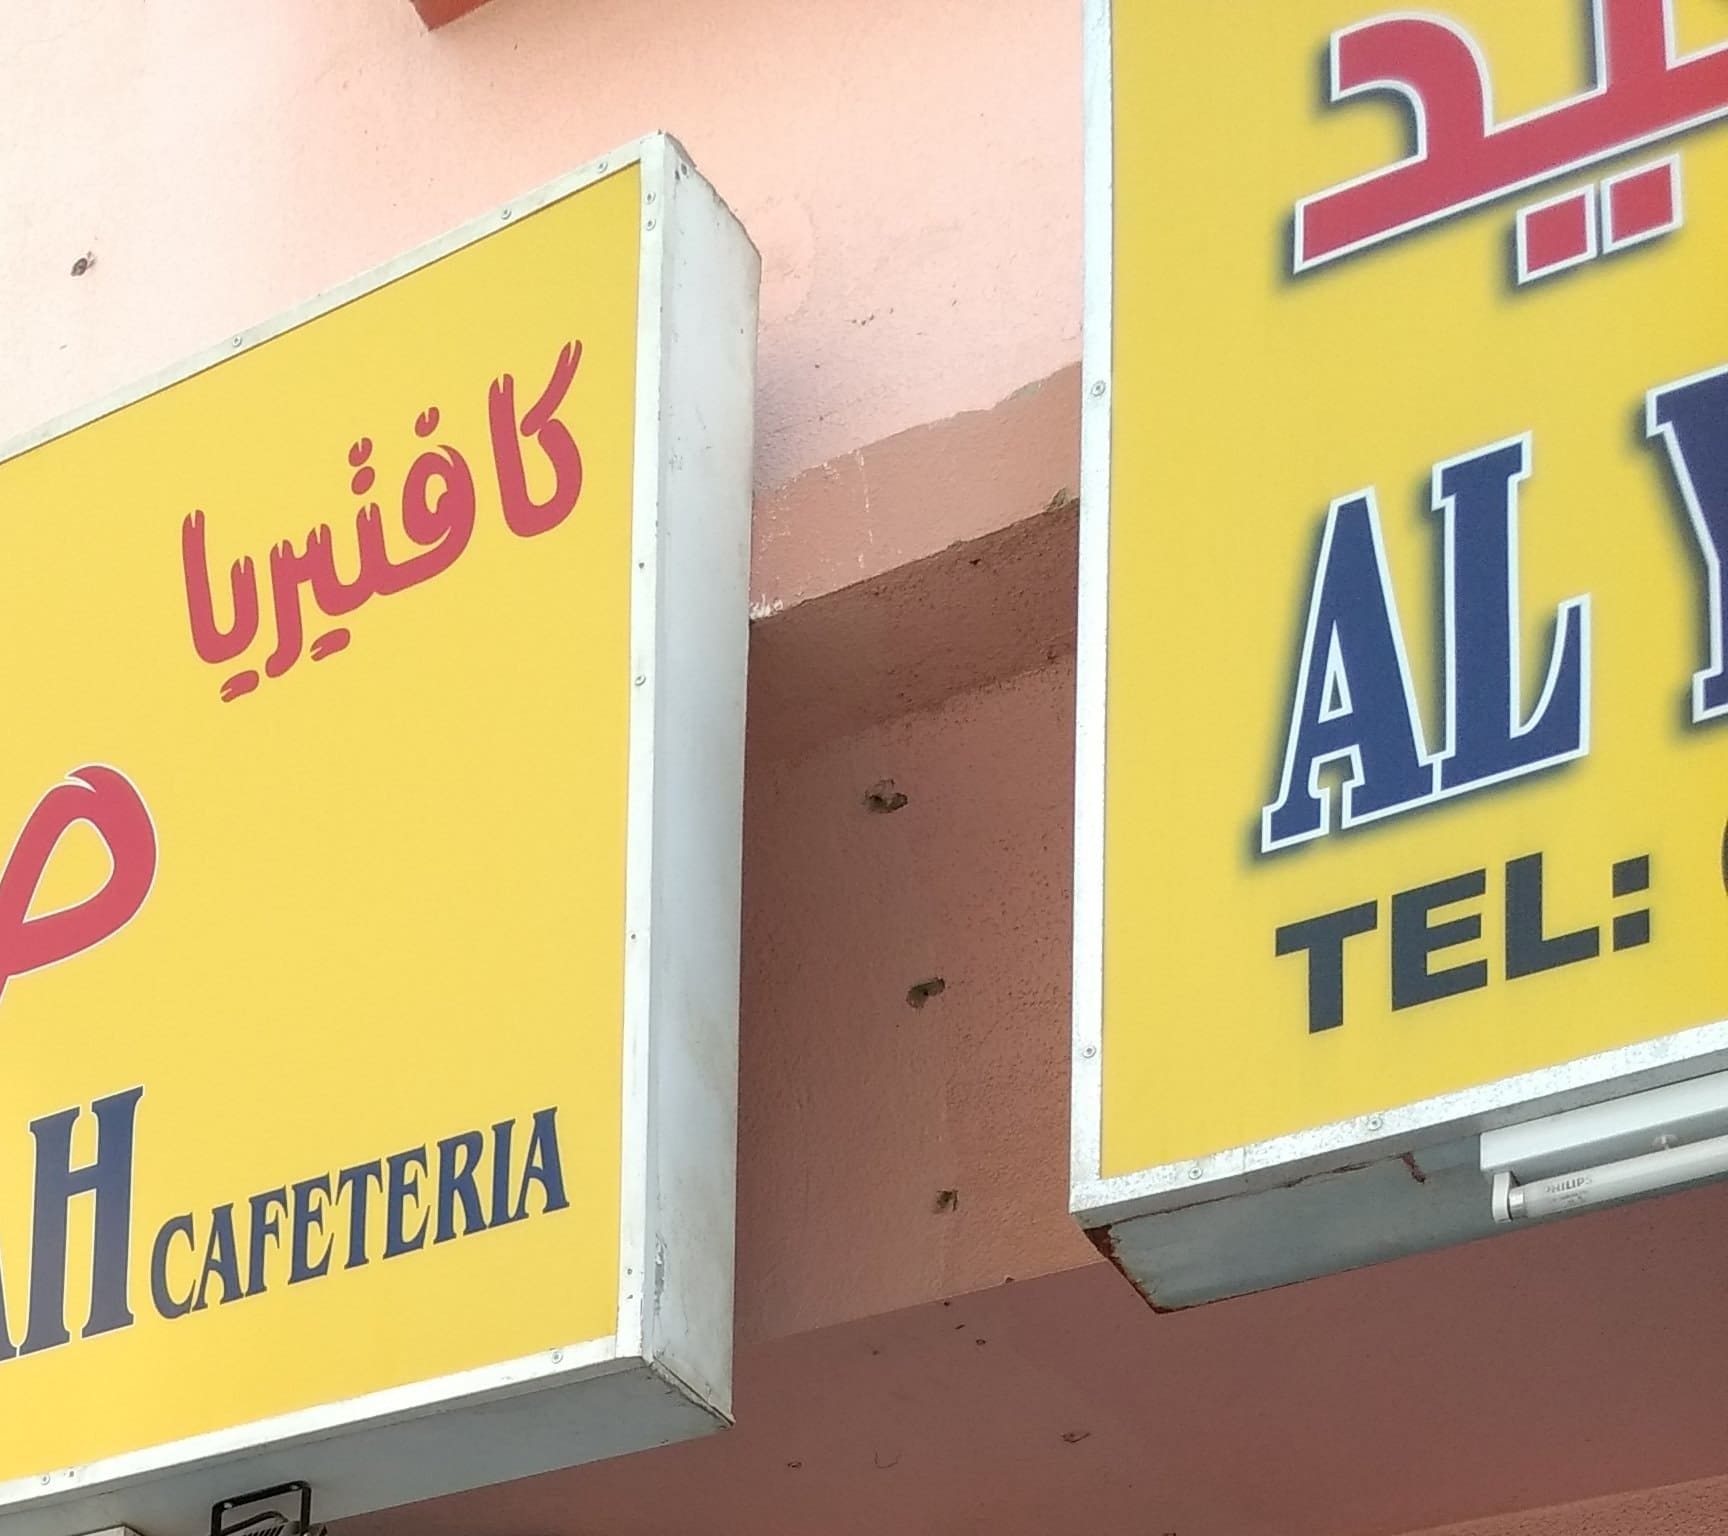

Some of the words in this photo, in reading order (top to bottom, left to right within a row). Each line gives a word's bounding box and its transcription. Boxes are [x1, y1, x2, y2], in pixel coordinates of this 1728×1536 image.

[181, 339, 584, 702] كافتيريا
[1260, 430, 1592, 855] AL
[1275, 851, 1651, 1036] TEL:
[149, 1106, 570, 1321] CAFETERIA
